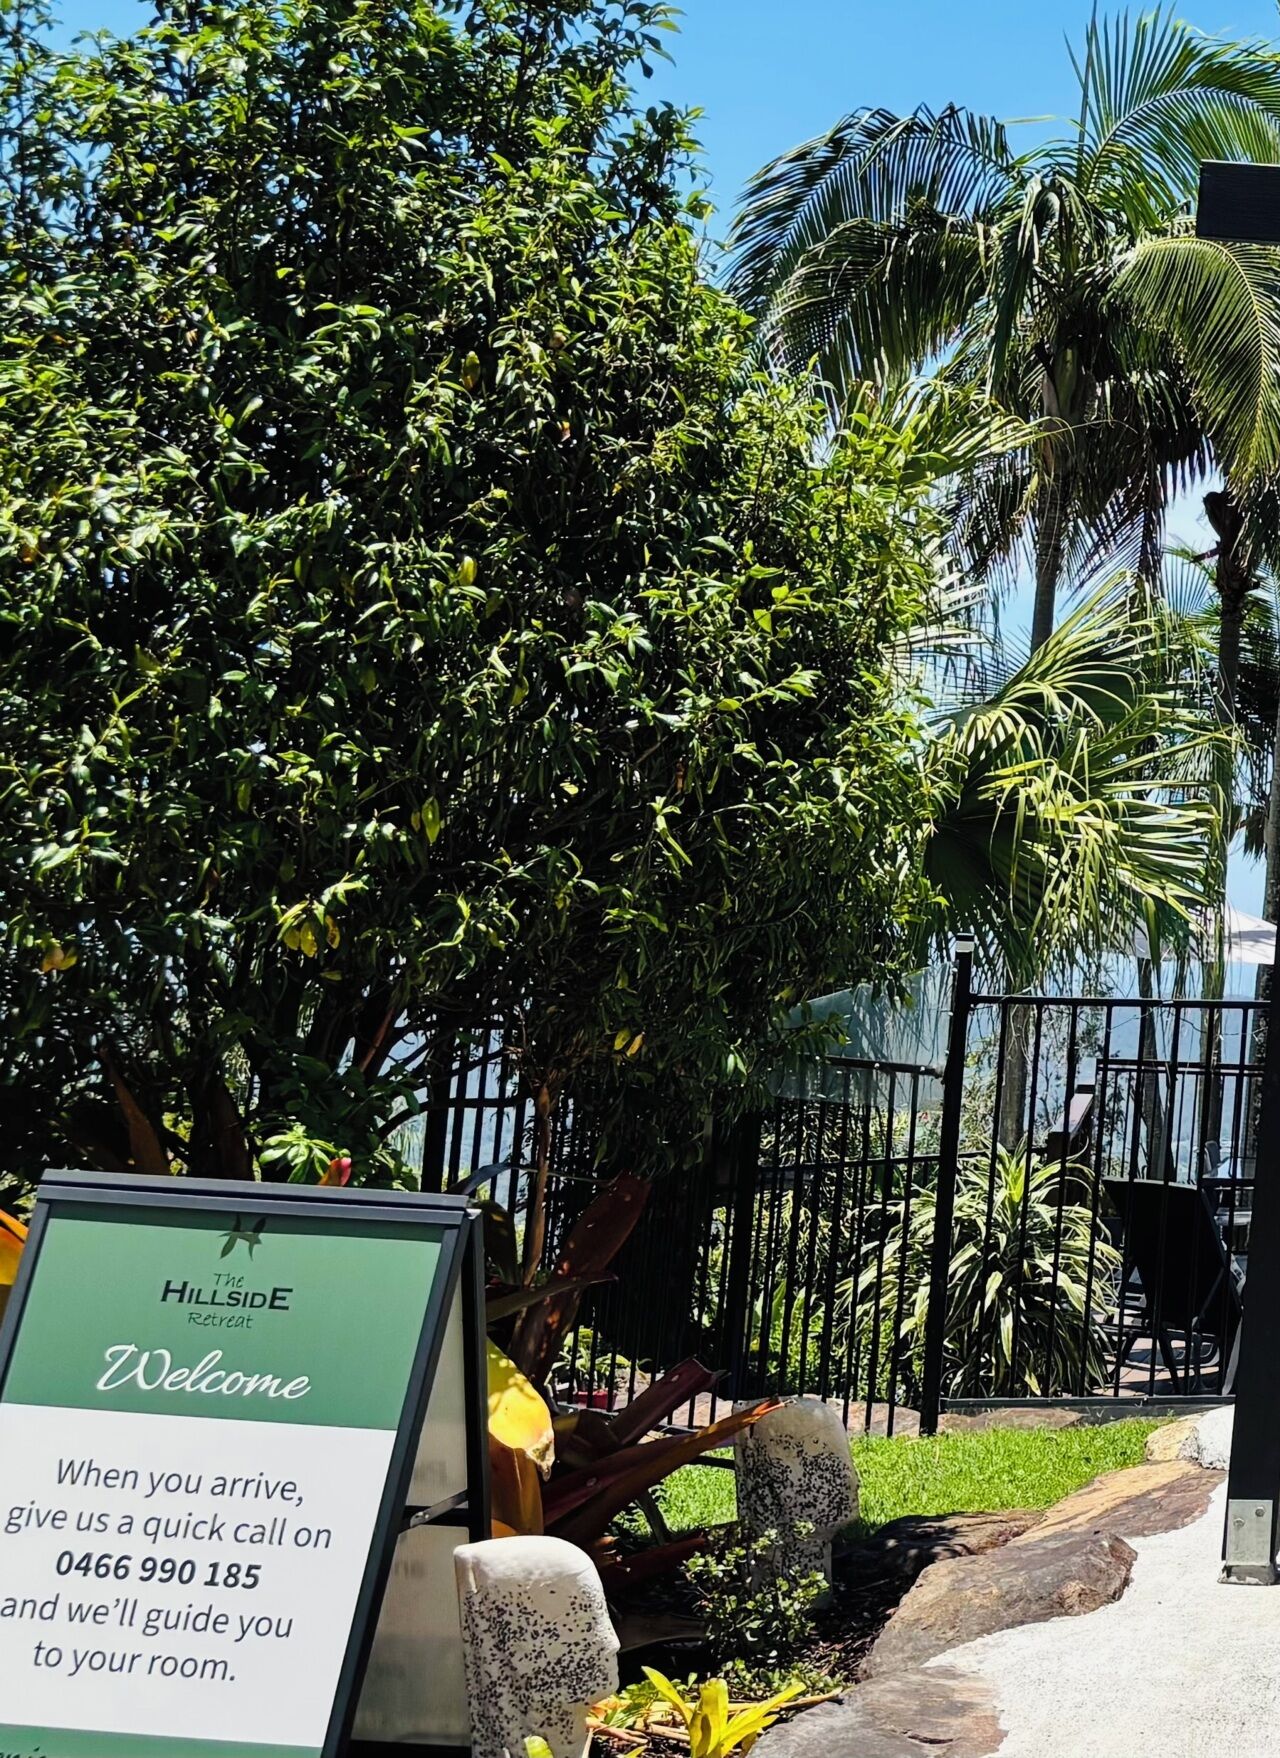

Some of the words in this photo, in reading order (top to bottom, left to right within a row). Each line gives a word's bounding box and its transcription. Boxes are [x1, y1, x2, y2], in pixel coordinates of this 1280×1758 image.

[160, 1280, 293, 1310] HILLSIDE
[213, 1272, 245, 1289] The
[187, 1311, 254, 1329] Retreat
[96, 1343, 311, 1400] Welcome
[56, 1458, 139, 1490] When
[145, 1466, 202, 1498] you
[210, 1472, 304, 1506] arrive,
[4, 1500, 68, 1535] give
[75, 1509, 108, 1533] us
[117, 1513, 133, 1535] a
[143, 1509, 226, 1545] quick
[233, 1517, 287, 1548] call
[294, 1527, 332, 1548] on
[55, 1551, 131, 1580] 0466
[138, 1556, 196, 1586] 990
[203, 1562, 261, 1590] 185
[0, 1592, 60, 1622] and
[67, 1597, 136, 1628] we’ll
[142, 1603, 230, 1637] guide
[234, 1610, 293, 1643] you
[33, 1640, 63, 1669] to
[68, 1649, 142, 1677] your
[148, 1653, 237, 1681] room.
